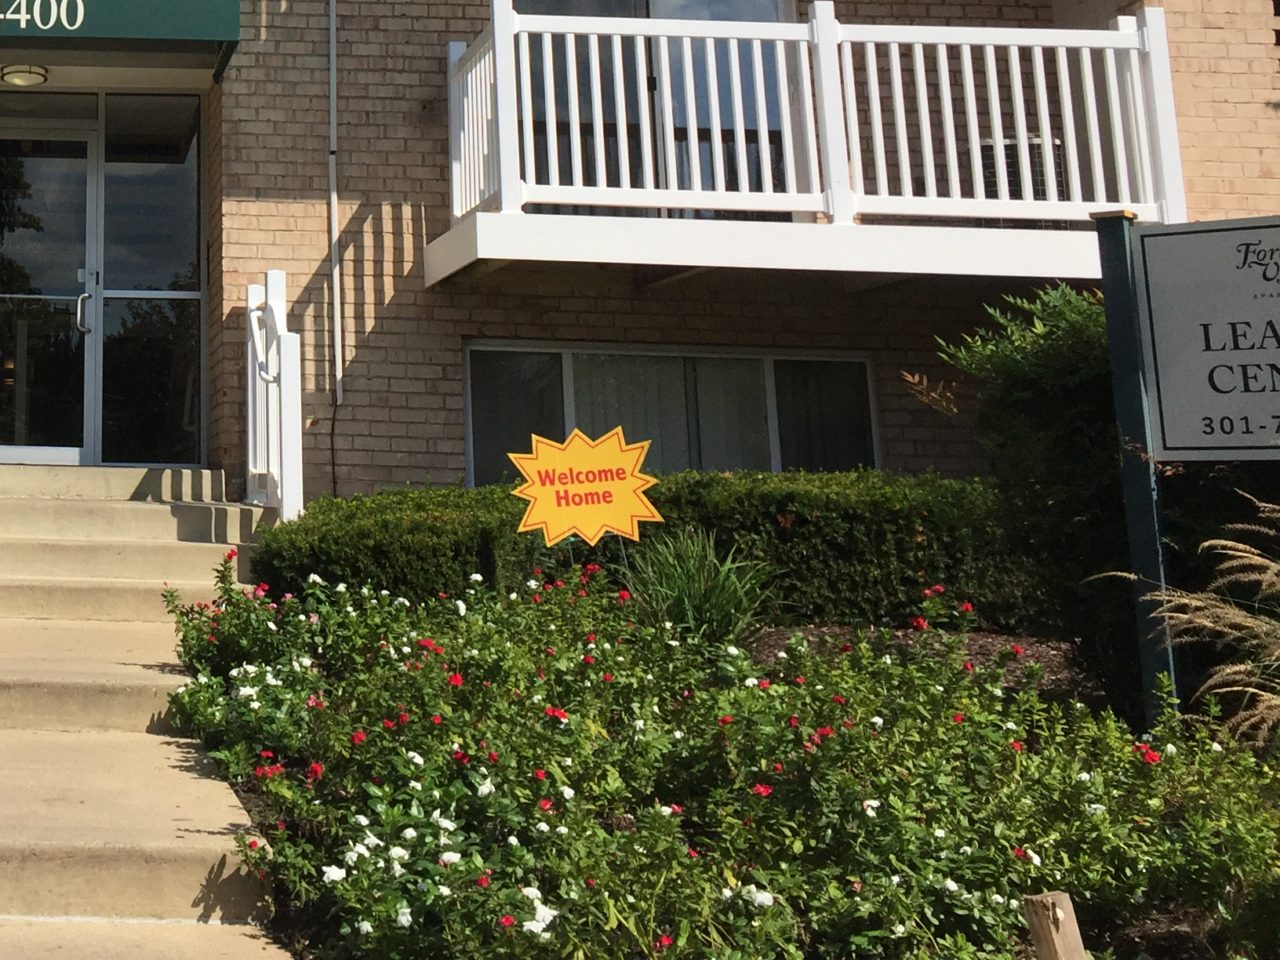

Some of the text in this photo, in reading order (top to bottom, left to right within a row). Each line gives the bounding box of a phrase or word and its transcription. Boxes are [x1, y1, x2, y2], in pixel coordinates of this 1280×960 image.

[1235, 239, 1280, 270] For
[1199, 319, 1280, 352] LEA
[1201, 414, 1280, 436] 301-7
[537, 466, 627, 487] Welcome
[555, 489, 614, 508] Home
